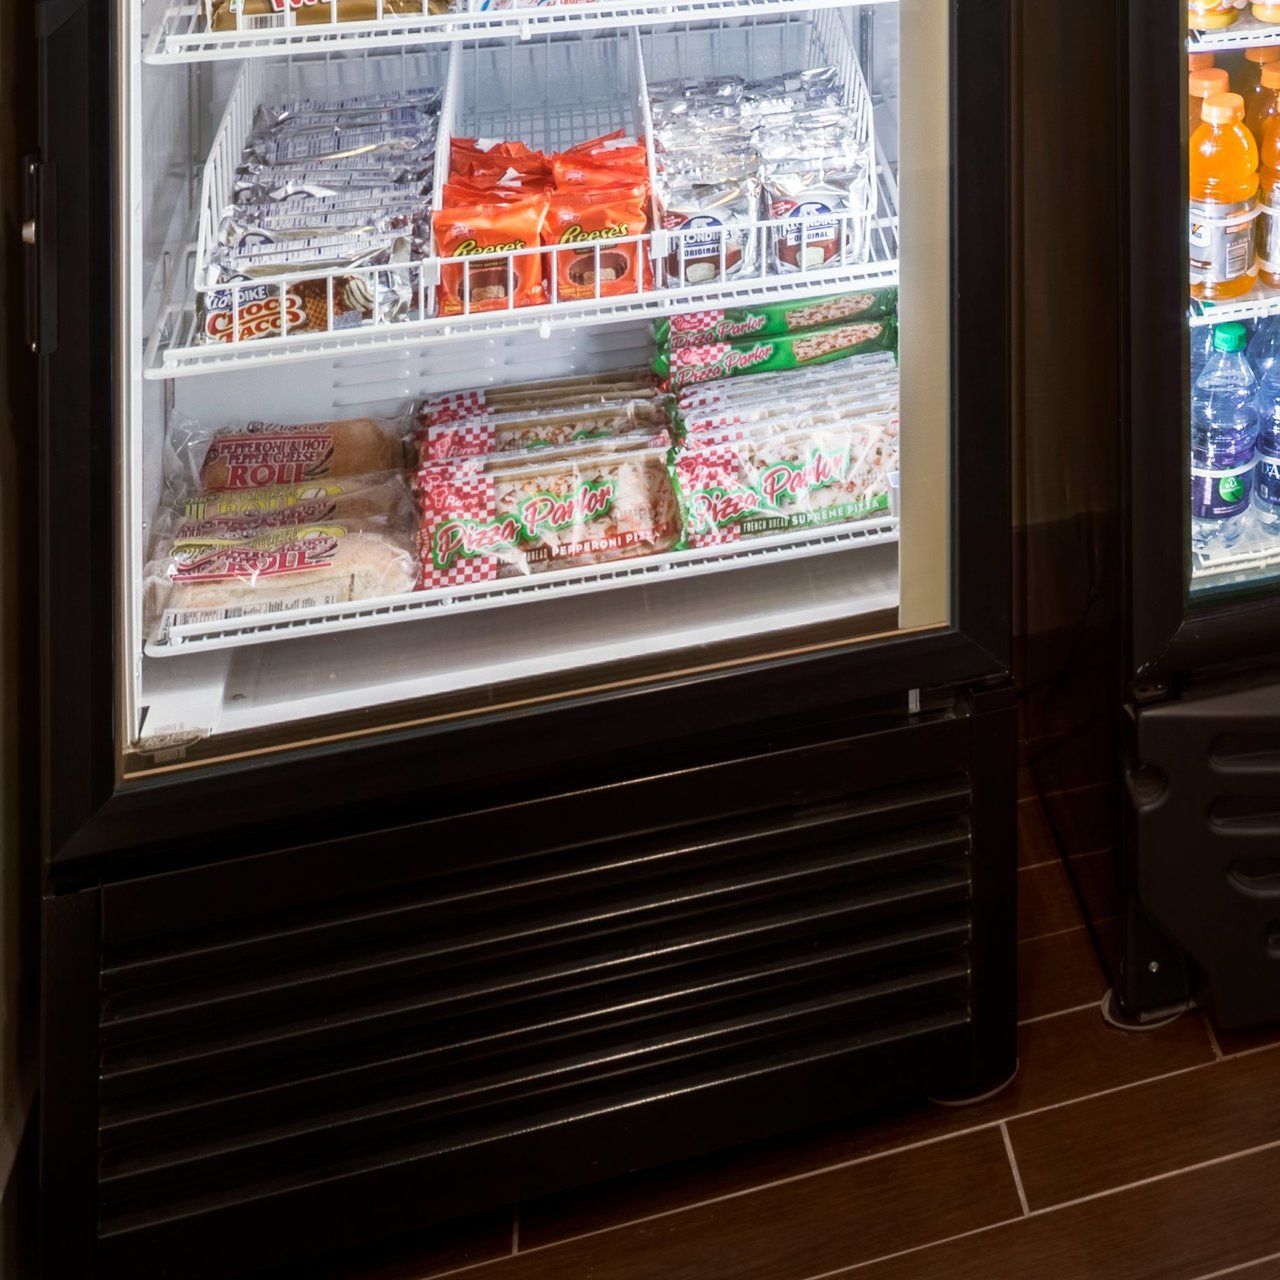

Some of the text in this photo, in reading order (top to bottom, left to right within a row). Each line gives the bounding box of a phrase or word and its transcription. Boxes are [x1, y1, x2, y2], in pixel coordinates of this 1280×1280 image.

[559, 223, 629, 245] Reese's
[718, 315, 766, 341] Parlor
[676, 344, 774, 385] Pizza Parlor
[436, 481, 615, 566] Pizza Parlor
[551, 536, 622, 557] PEPPERONI
